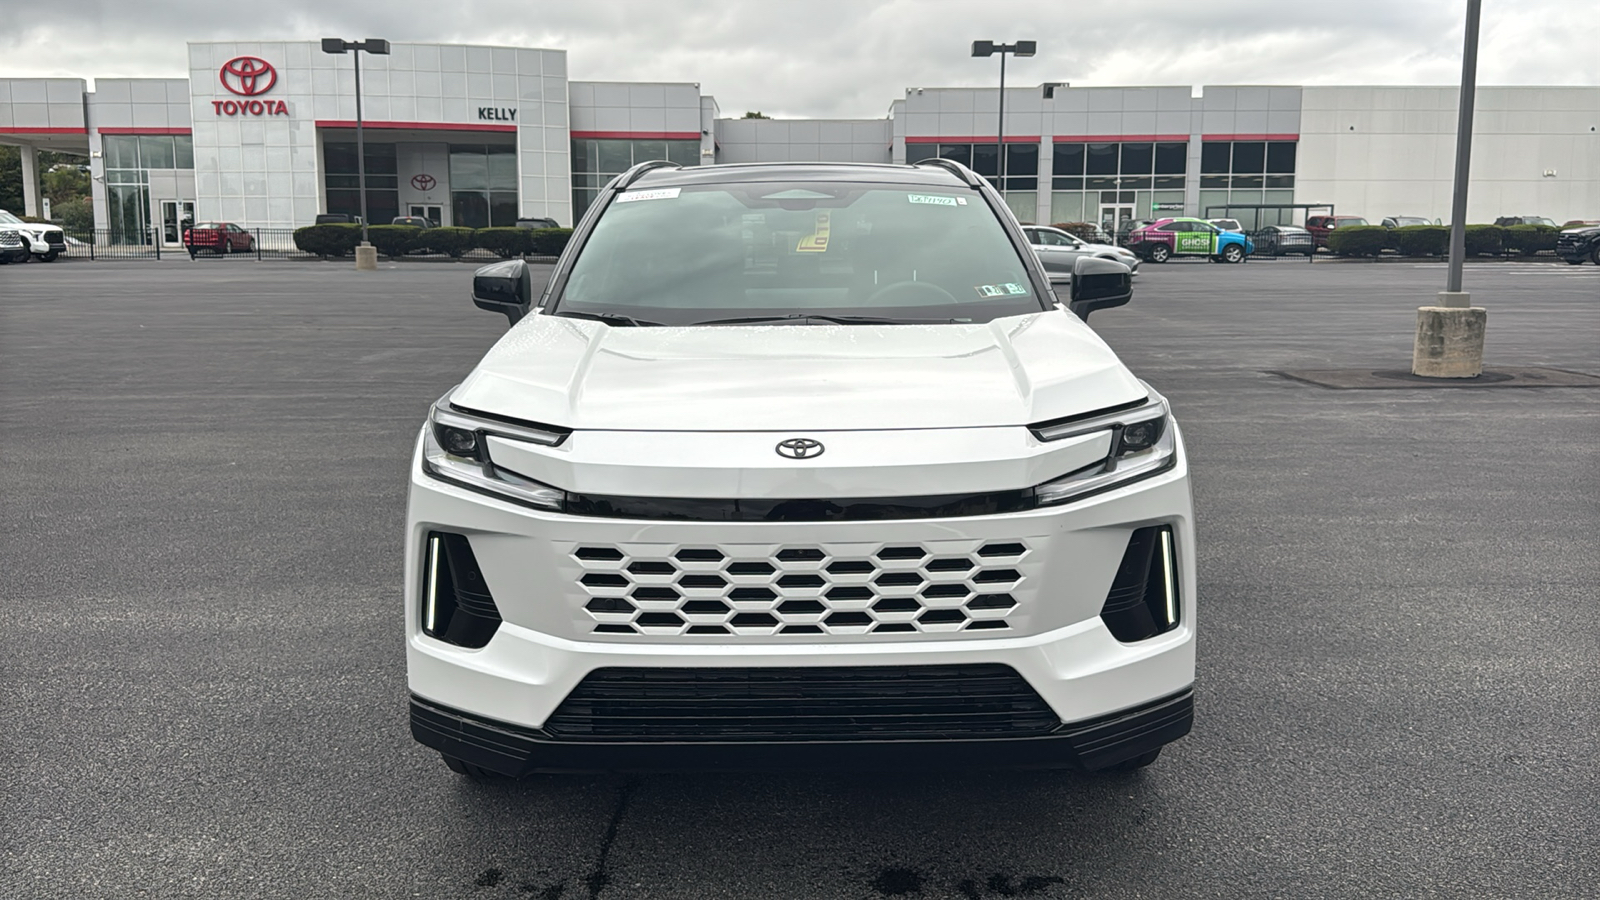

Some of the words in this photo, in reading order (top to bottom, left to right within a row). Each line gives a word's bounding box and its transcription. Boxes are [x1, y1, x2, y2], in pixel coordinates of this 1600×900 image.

[211, 100, 289, 116] TOYOTA
[478, 107, 517, 121] KELLY
[815, 214, 829, 245] OLD
